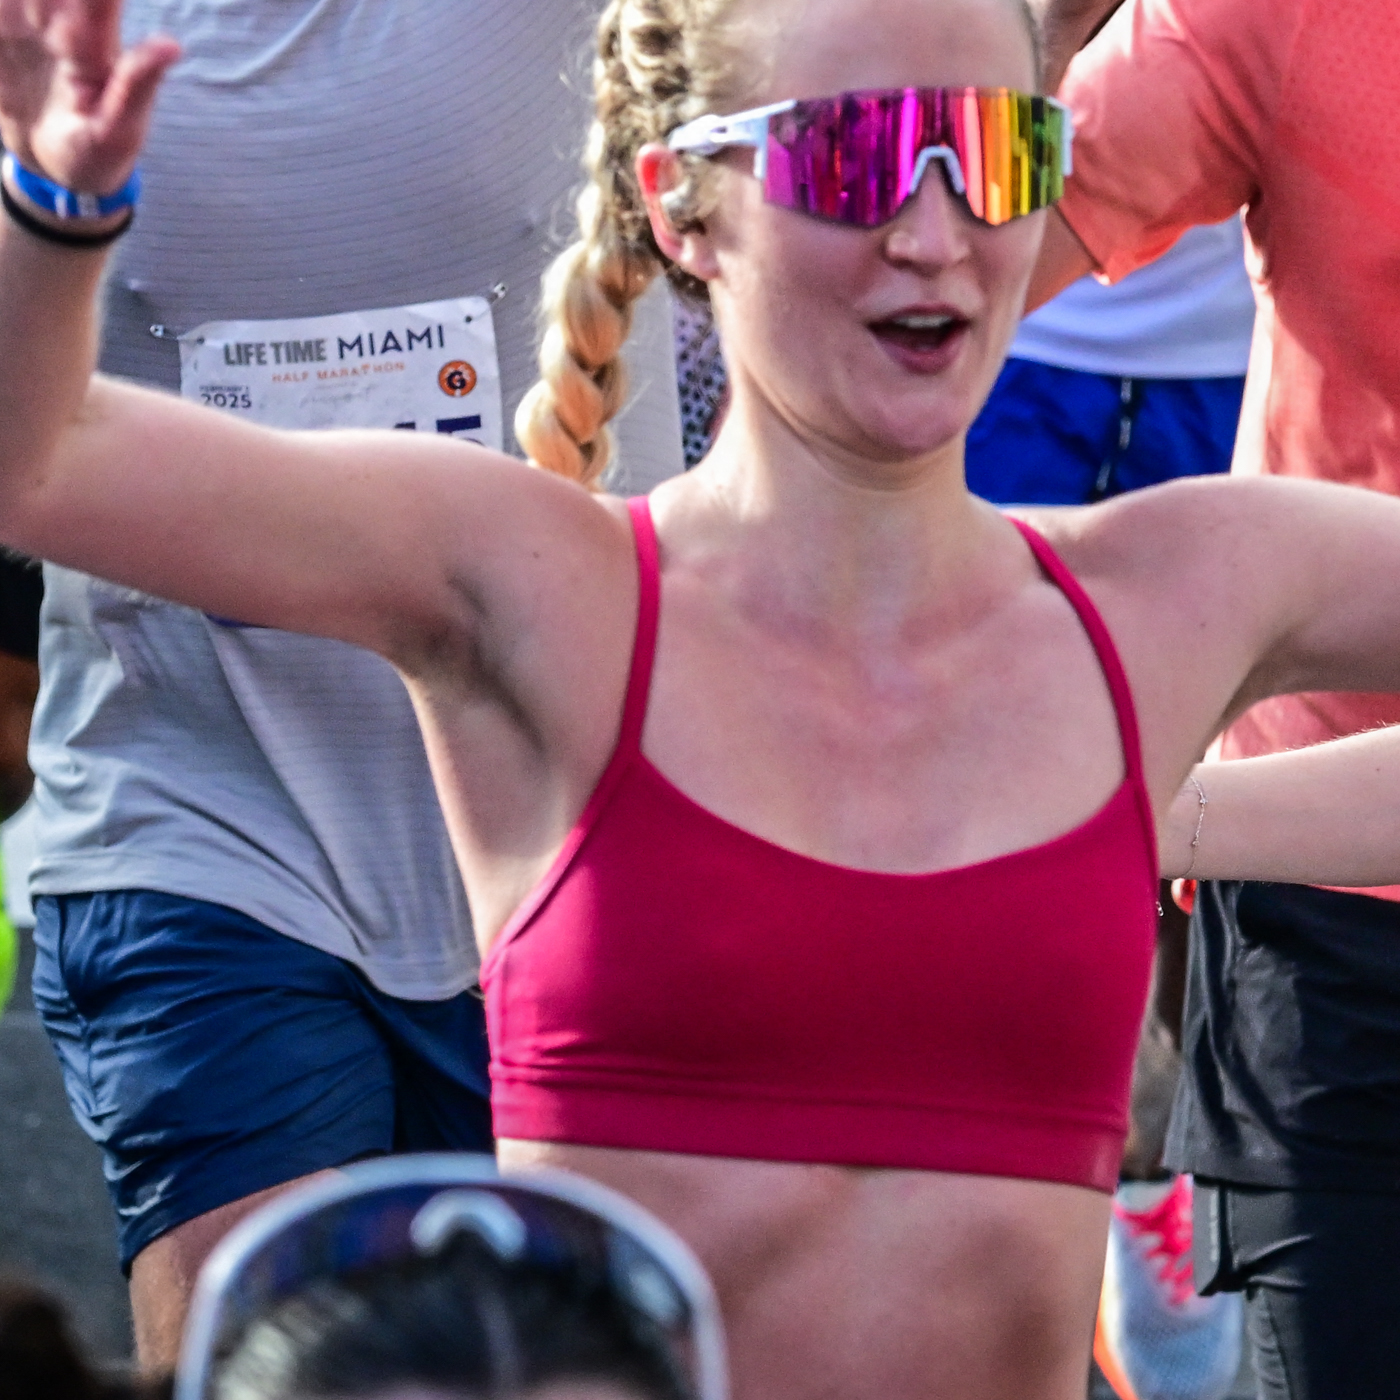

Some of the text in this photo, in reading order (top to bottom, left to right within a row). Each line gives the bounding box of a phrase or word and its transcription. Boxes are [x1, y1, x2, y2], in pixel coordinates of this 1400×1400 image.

[337, 325, 444, 360] MIAMI
[272, 361, 405, 383] HALF MARATHON
[200, 392, 252, 409] 2025
